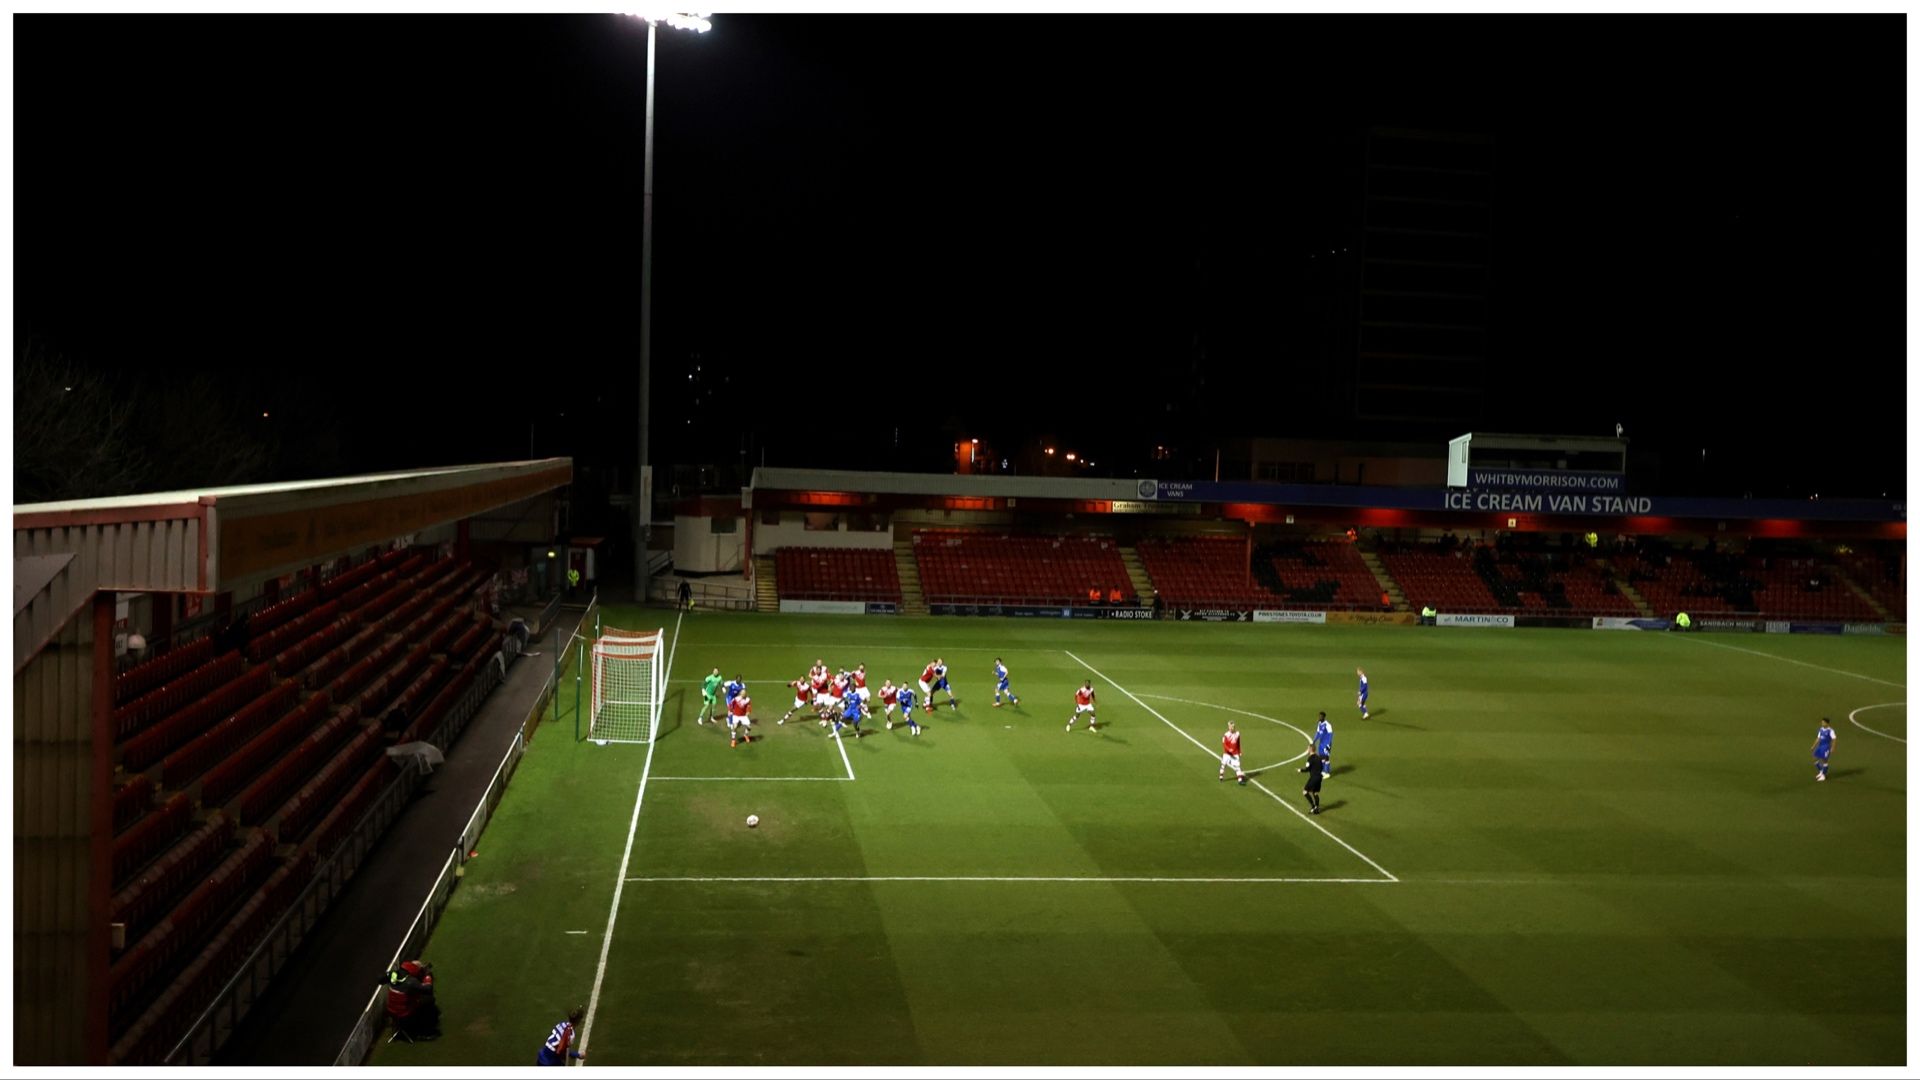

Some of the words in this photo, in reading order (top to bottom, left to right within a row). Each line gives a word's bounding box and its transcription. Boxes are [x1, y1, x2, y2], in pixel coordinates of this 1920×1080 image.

[1475, 472, 1619, 489] WHITBYMORRISON.COM
[1169, 483, 1193, 491] CREAM
[1167, 490, 1184, 498] VANS
[1444, 493, 1471, 510] ICE
[1477, 493, 1542, 511] CREAM
[1548, 494, 1586, 512] VAN
[1592, 495, 1652, 513] STAND
[1115, 609, 1134, 619] RADIO
[1134, 610, 1153, 620] STOKE
[1454, 616, 1491, 624] MARTIN
